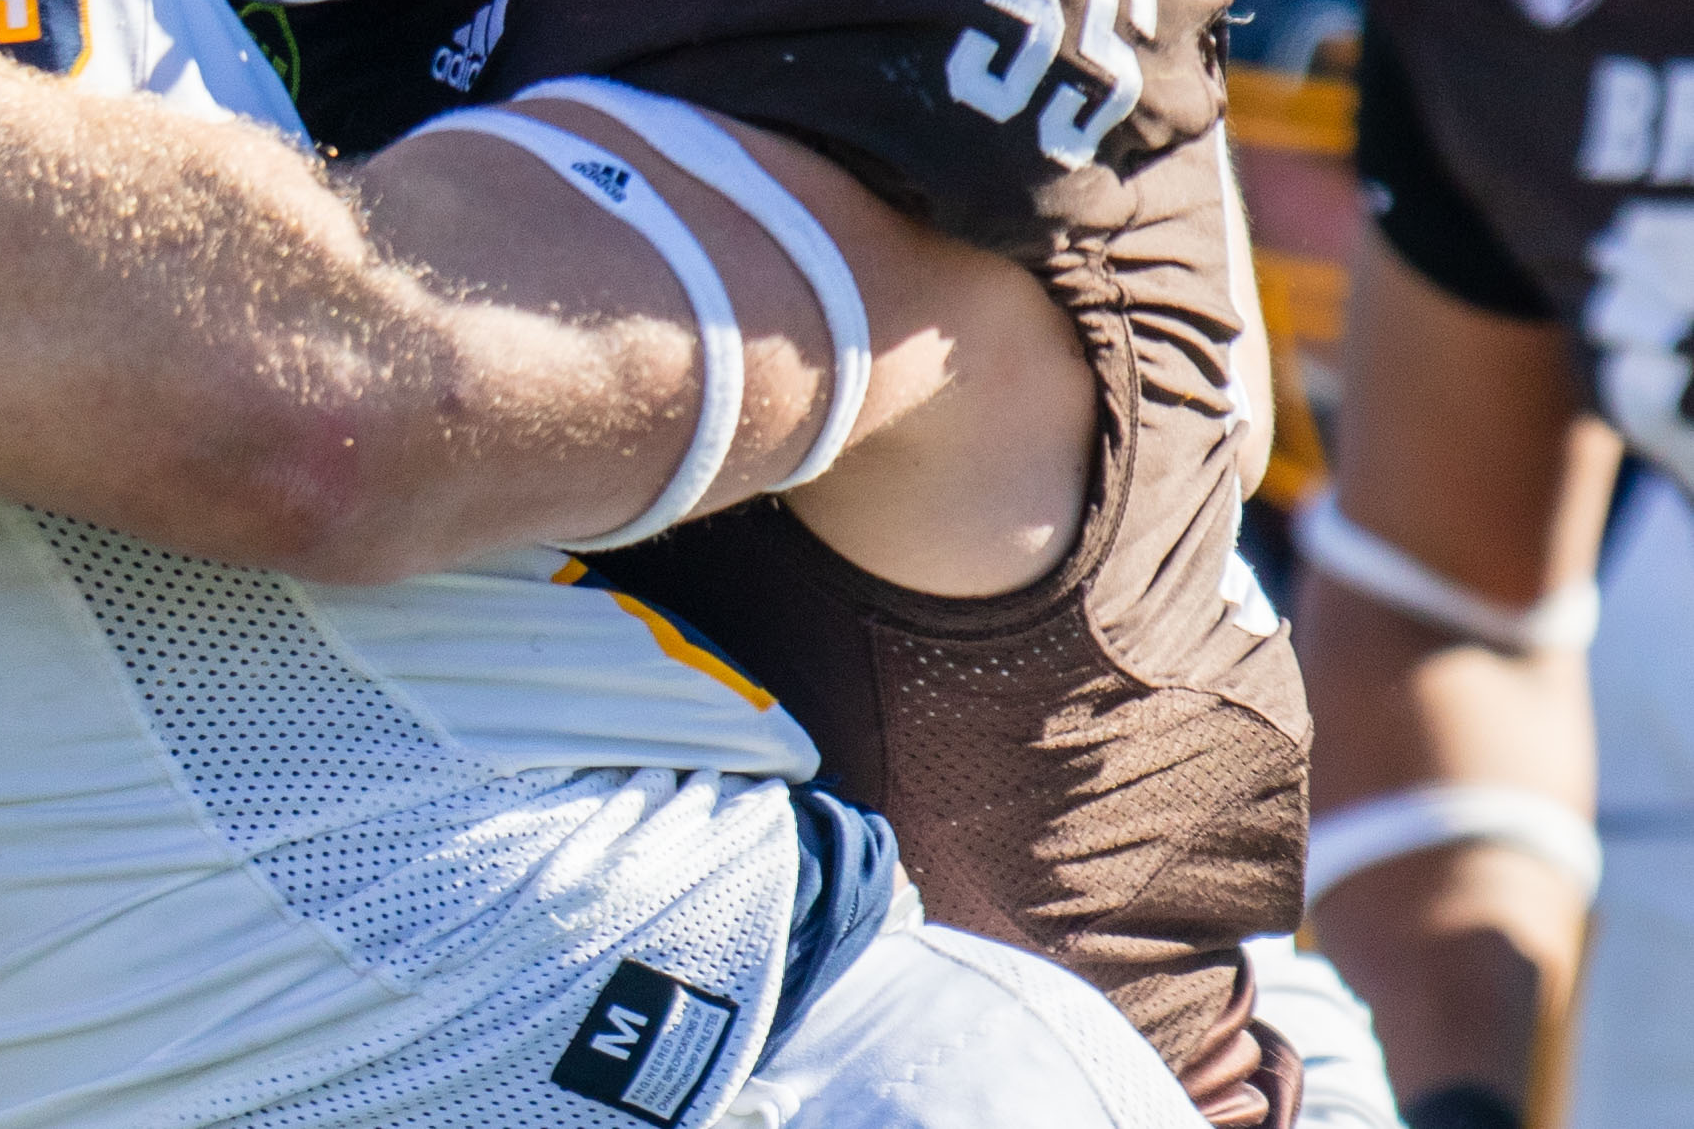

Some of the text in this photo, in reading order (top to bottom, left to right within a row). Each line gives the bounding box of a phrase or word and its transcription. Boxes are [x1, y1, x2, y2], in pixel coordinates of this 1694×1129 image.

[590, 1003, 650, 1062] M
[630, 1038, 673, 1101] ENGINEERED
[644, 1080, 665, 1106] EXACT
[662, 1019, 699, 1083] SPECIFICATIONS
[657, 1013, 720, 1111] CHAMPIONSHIP ATHLETES
